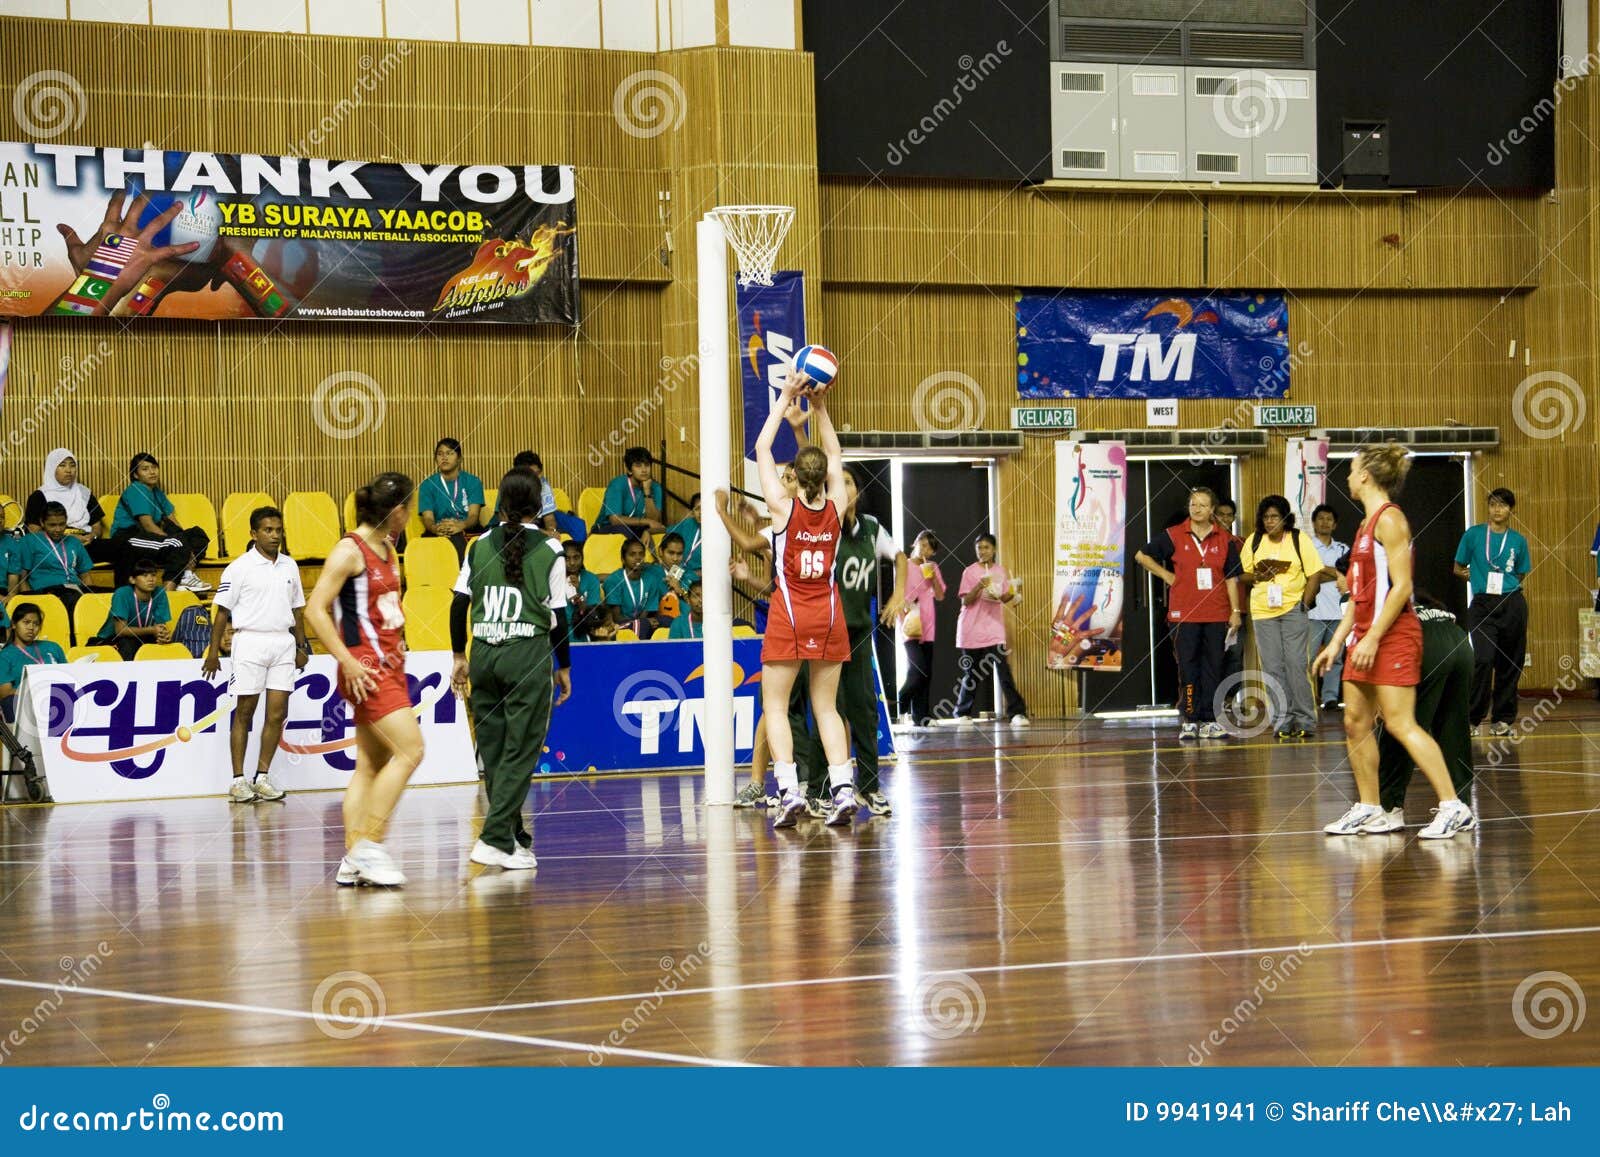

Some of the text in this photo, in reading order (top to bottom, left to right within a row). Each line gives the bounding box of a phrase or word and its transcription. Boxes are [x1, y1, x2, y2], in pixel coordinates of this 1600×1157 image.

[35, 144, 576, 204] THANK YOU
[218, 203, 256, 224] YB
[265, 204, 372, 228] SURAYA
[378, 209, 484, 231] YAACOB
[218, 227, 281, 237] PRESIDENT
[284, 228, 298, 237] OF
[301, 229, 361, 240] MALAYSIAN
[364, 231, 409, 241] NETBALL
[413, 233, 482, 243] ASSOCIATION
[459, 271, 499, 286] KELAB
[298, 307, 425, 318] www.kelabautoshow.com
[472, 303, 486, 313] the
[1089, 332, 1197, 381] TM
[1019, 409, 1062, 426] KELUAR
[1153, 407, 1174, 416] WEST
[1261, 407, 1302, 425] KELUAR
[842, 556, 876, 592] GK
[483, 586, 523, 622] WD
[508, 623, 536, 638] BANK
[620, 696, 755, 755] TM
